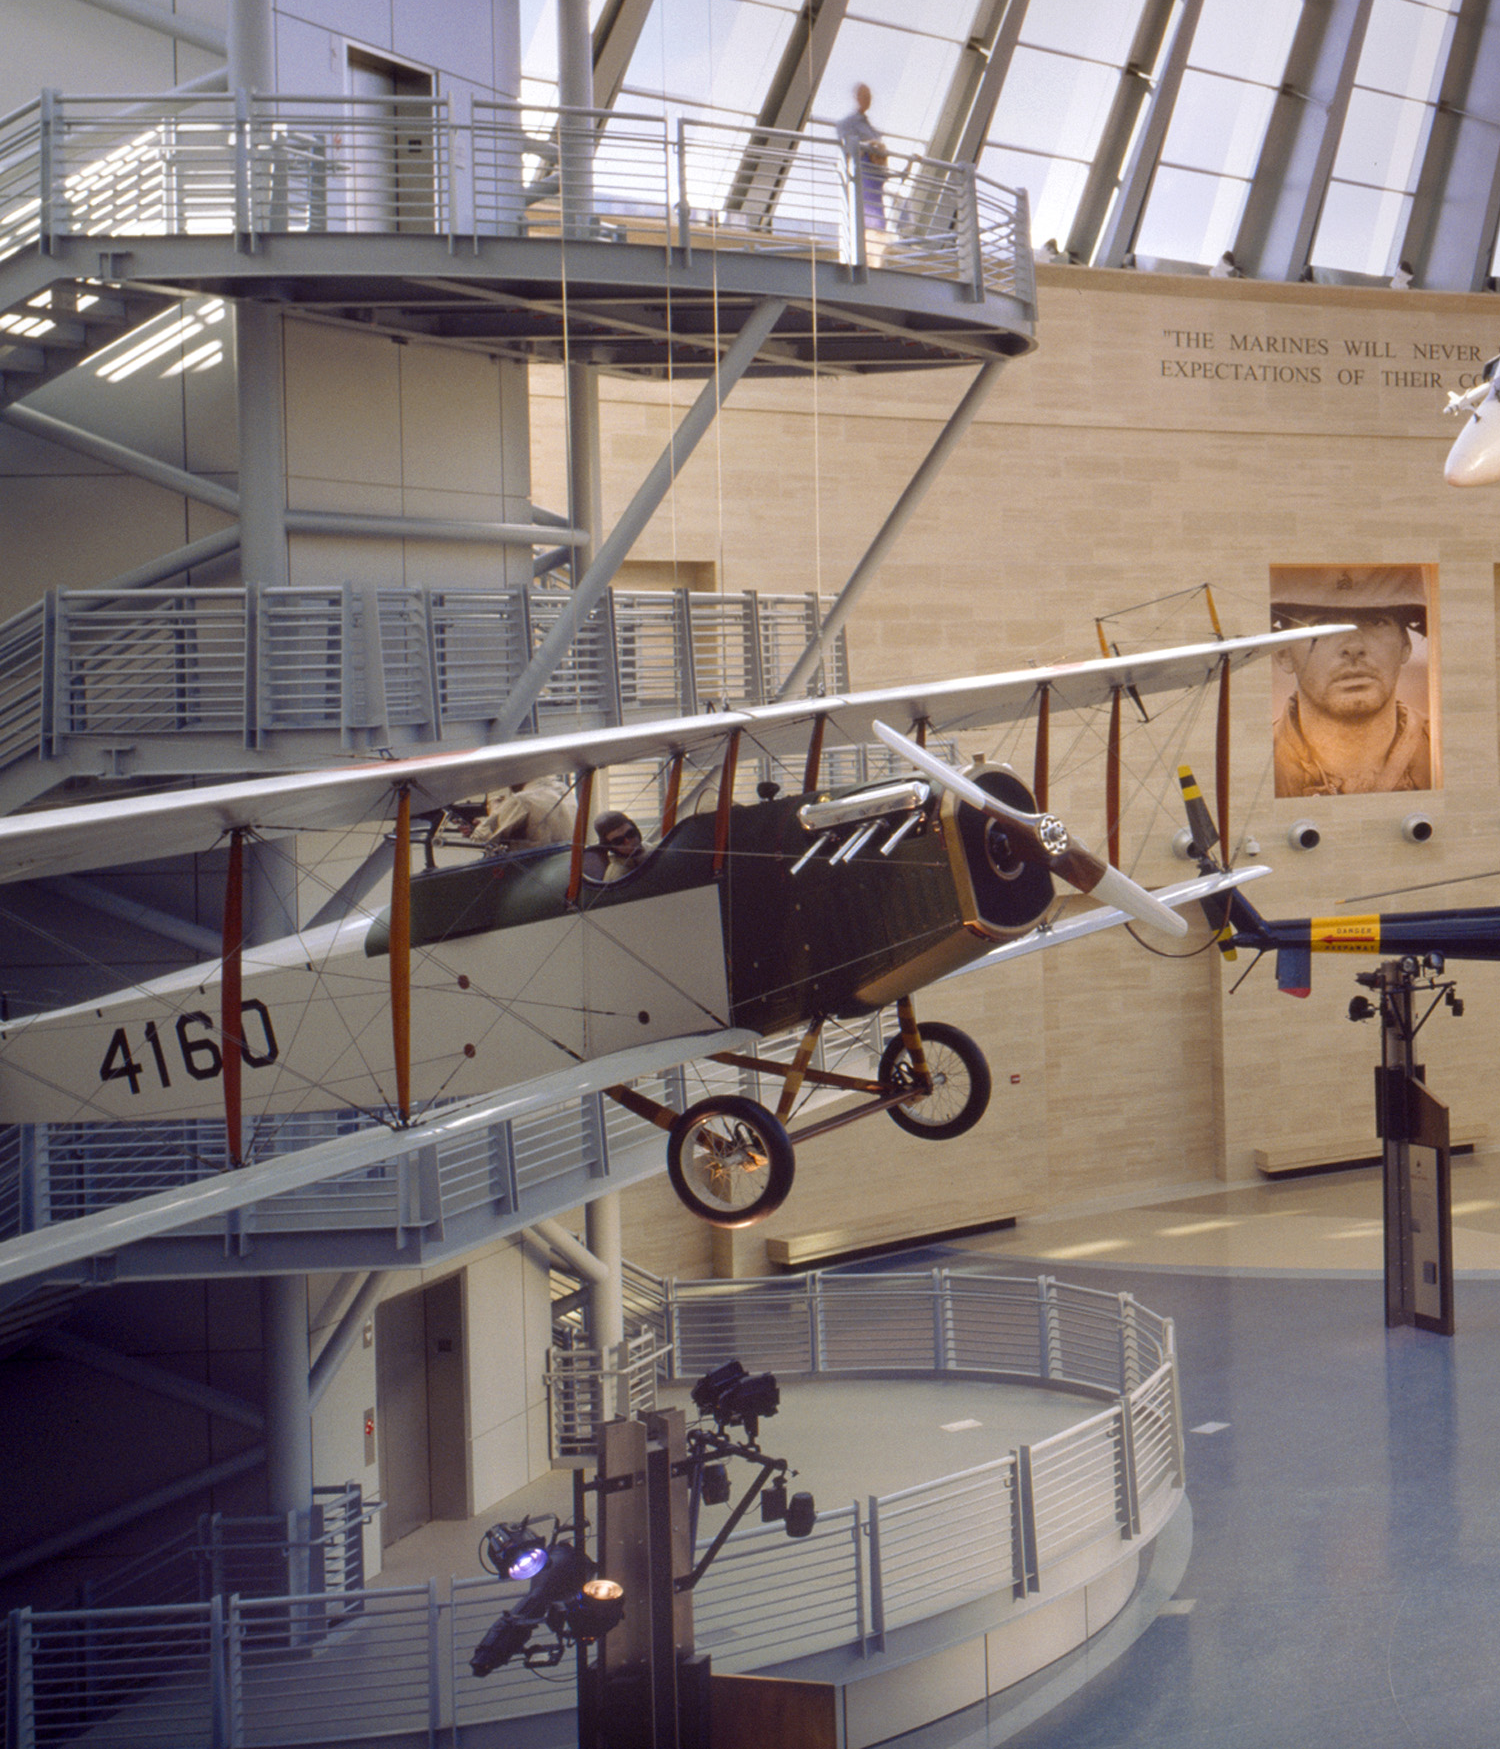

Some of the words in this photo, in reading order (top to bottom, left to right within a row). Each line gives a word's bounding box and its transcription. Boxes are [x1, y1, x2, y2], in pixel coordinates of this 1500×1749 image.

[1163, 330, 1214, 349] "THE
[1230, 334, 1329, 355] MARINES
[1344, 340, 1396, 358] WILL
[1413, 343, 1483, 361] NEVER
[1161, 360, 1321, 384] EXPECTATIONS
[1338, 369, 1365, 385] OF
[1381, 371, 1443, 388] THEIR
[99, 998, 280, 1095] 4160
